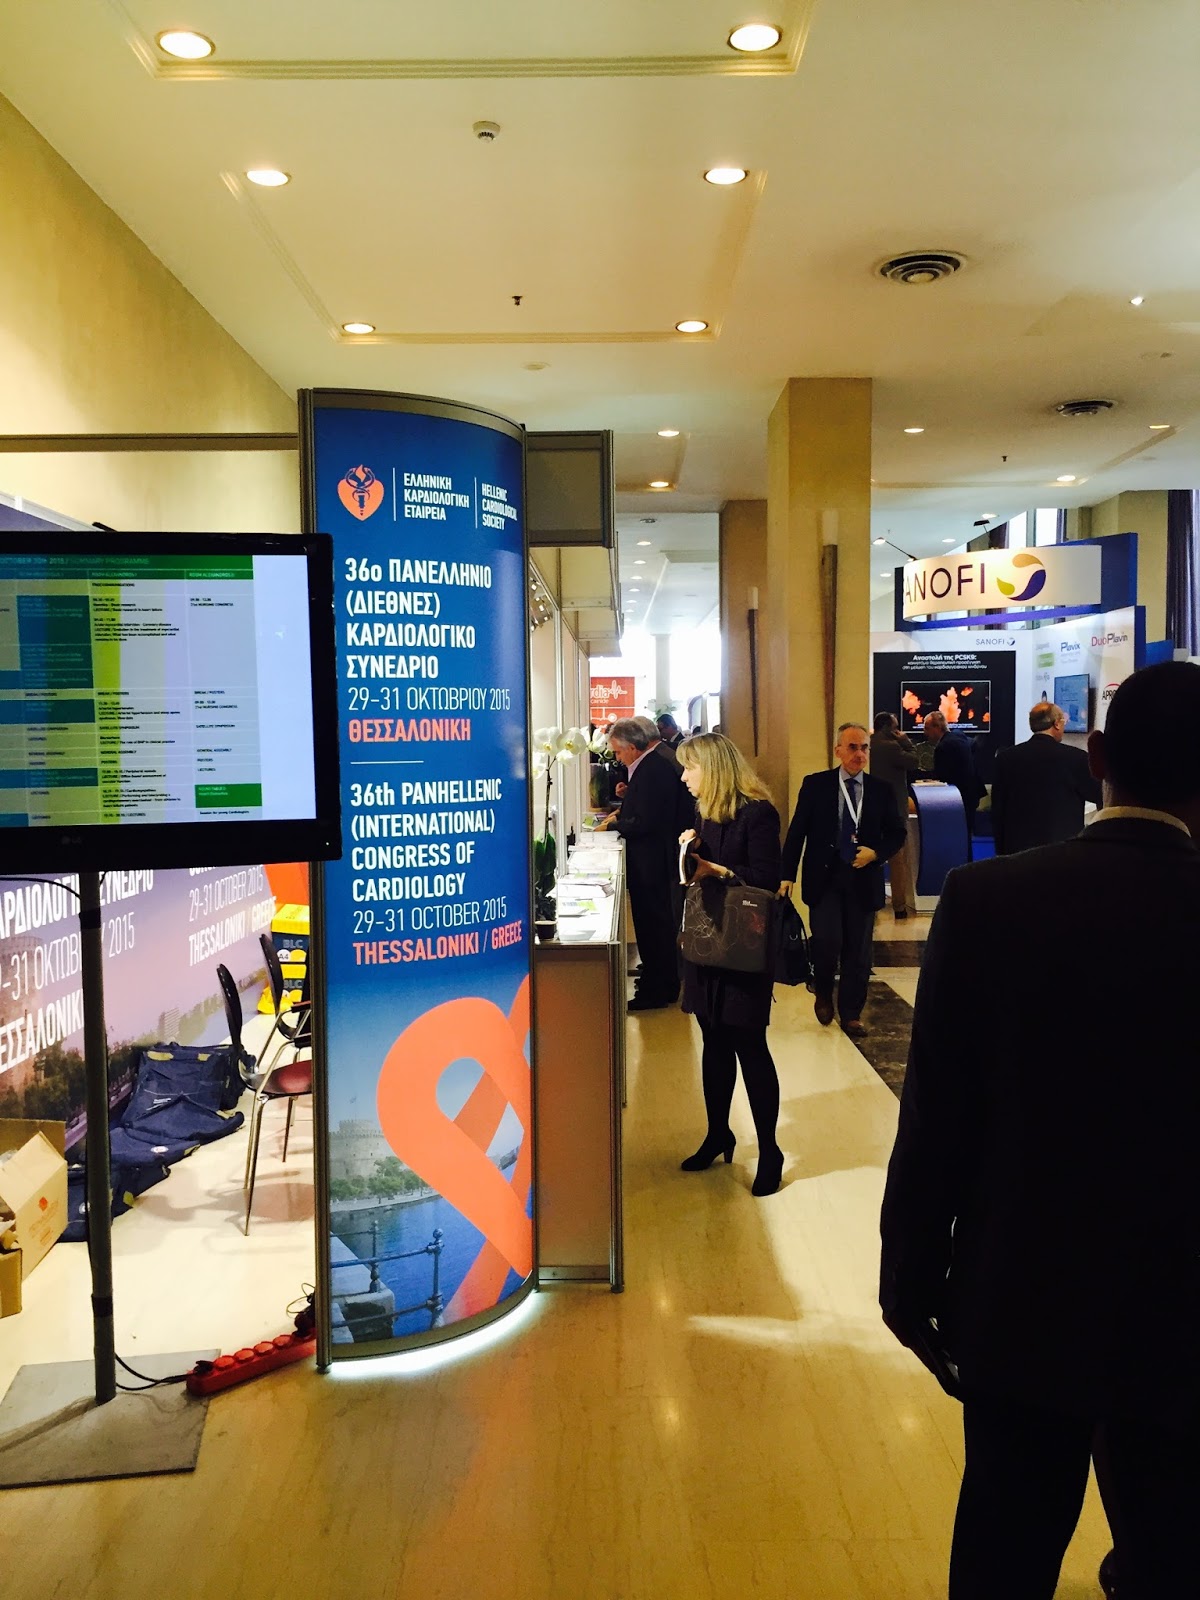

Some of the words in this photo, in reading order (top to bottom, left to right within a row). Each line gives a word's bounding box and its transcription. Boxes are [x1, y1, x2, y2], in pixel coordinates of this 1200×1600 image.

[403, 472, 452, 490] ΕΛΛΗΝΙΚΗ
[481, 482, 508, 502] HELLENIC
[403, 488, 470, 508] ΚΑΡΔΙΟΛΟΓΙΚΗ
[404, 504, 446, 521] ΕΤΑΙΡΕΙΑ
[482, 513, 505, 531] SOCIETY
[388, 558, 492, 589] ΠΑΝΕΛΛΗΝΙΟ
[345, 591, 441, 618] (ΔΙΕΘΝΕΣ)
[346, 622, 476, 649] ΚΑΡΔΙΟΛΟΓΙΚΟ
[976, 638, 1005, 646] SANOFI
[1060, 642, 1081, 652] Plavix
[346, 655, 439, 679] ΣΥΝΕΔΡΙΟ
[348, 686, 399, 711] 29-31
[406, 686, 487, 711] ΟΚΤΩΒΡΙΟΥ
[490, 687, 511, 711] 2015
[349, 718, 471, 743] ΘΕΣΣΑΛΟΝΙΚΗ
[350, 781, 395, 807] 36th
[401, 778, 502, 805] PANHELLENIC
[351, 808, 495, 841] (INTERNATIONAL)
[351, 843, 451, 870] CONGRESS
[455, 840, 475, 865] OF
[214, 870, 247, 910] OCTOBER
[247, 864, 264, 897] 2015
[352, 872, 466, 902] CARDIOLOGY
[353, 908, 404, 934] 29-31
[411, 901, 480, 931] OCTOBER
[483, 896, 507, 922] 2015
[109, 911, 135, 958] 2015
[189, 910, 246, 967] THESSALONIKI
[282, 939, 304, 949] BLC
[352, 931, 479, 966] THESSALONIKI
[491, 920, 522, 950] GREECE
